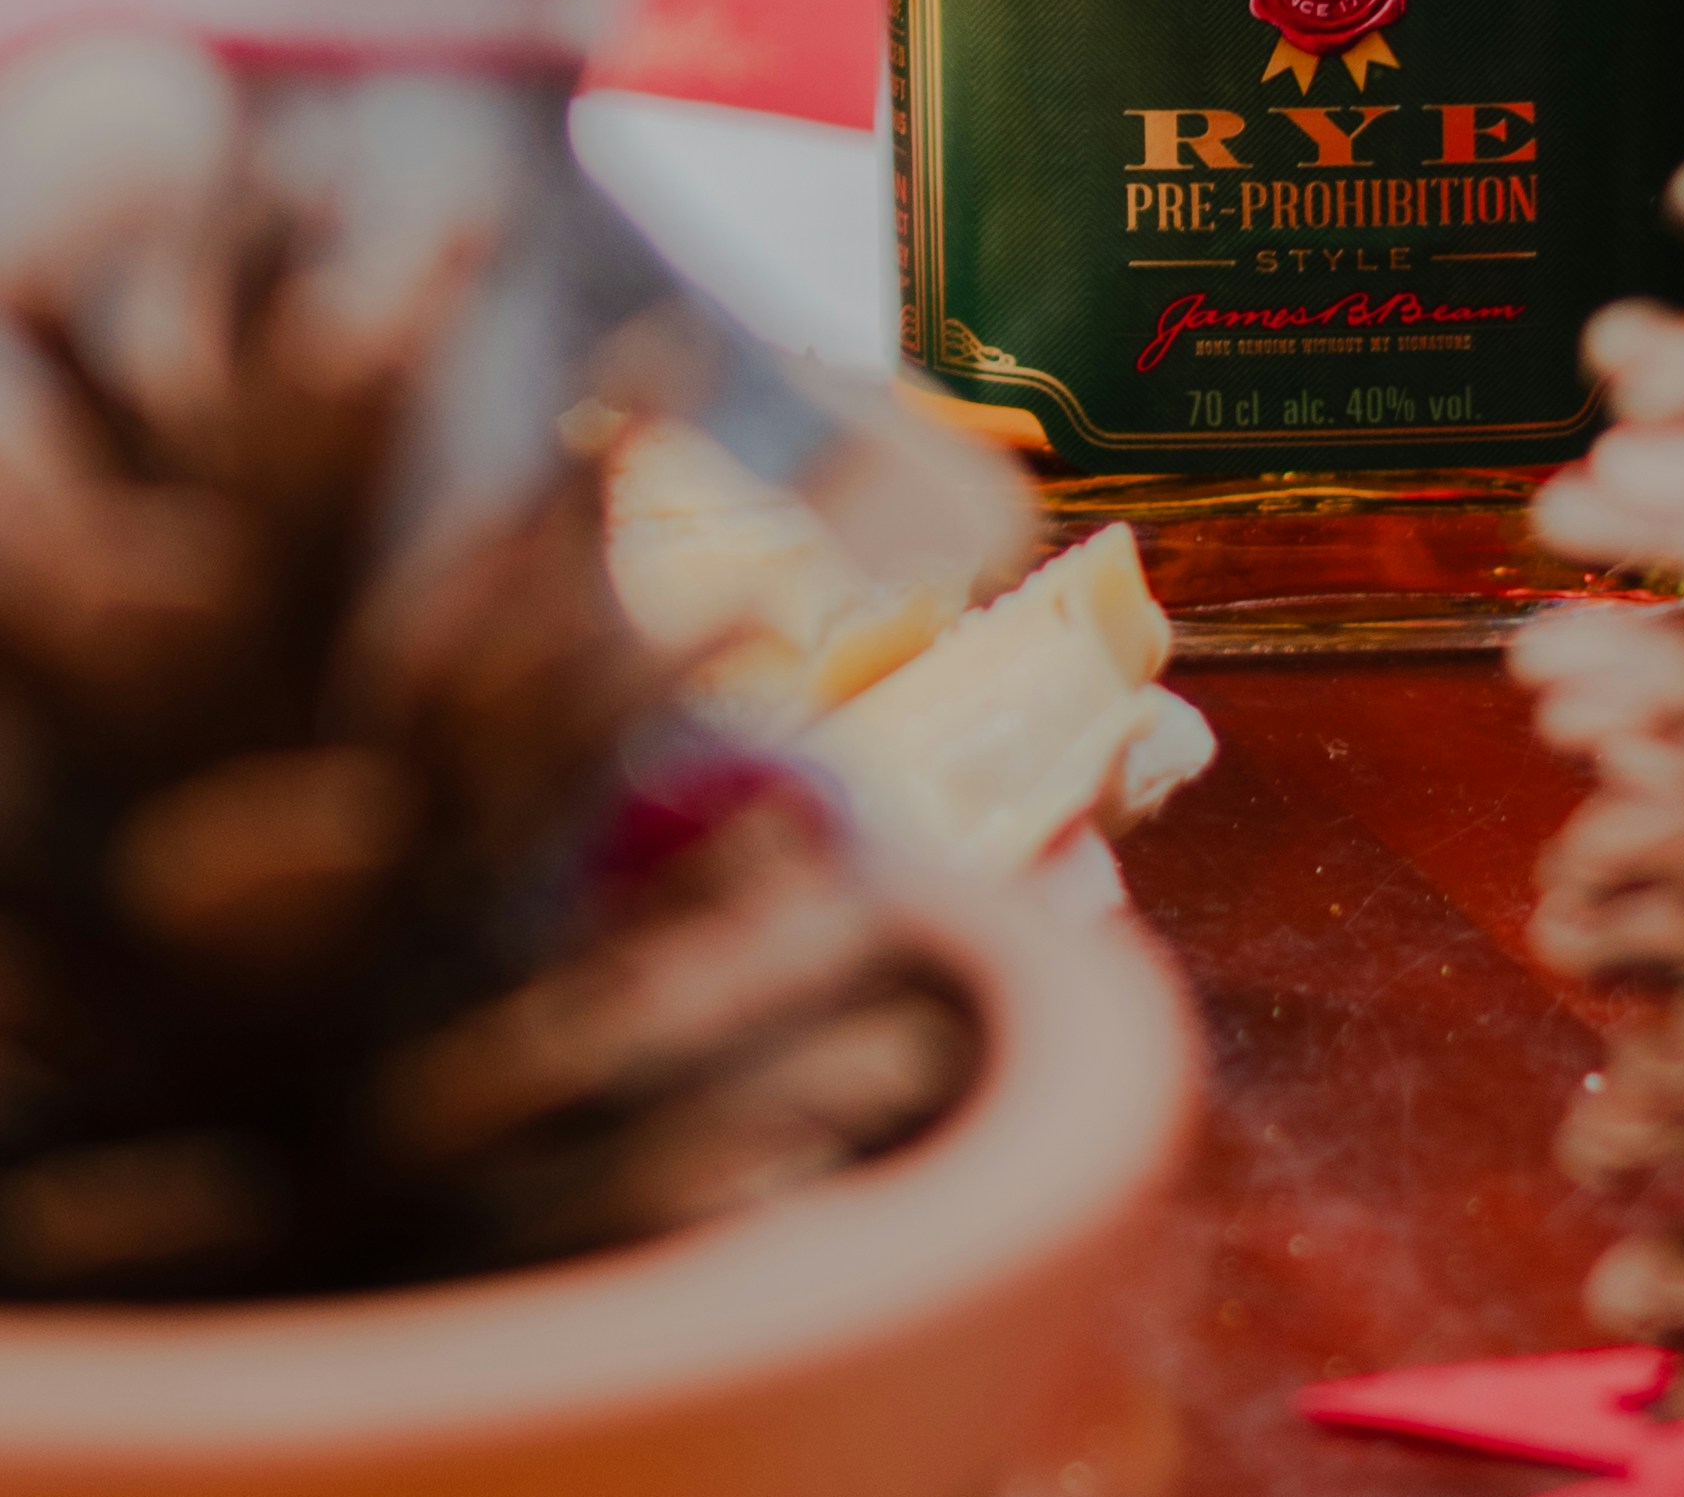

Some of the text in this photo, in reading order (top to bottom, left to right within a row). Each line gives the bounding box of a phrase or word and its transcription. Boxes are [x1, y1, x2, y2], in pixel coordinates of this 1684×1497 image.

[1123, 101, 1537, 171] RYE
[1125, 174, 1537, 232] PRE-PROHIBITION
[1255, 246, 1412, 272] STYLE
[1136, 292, 1316, 372] James
[1194, 334, 1471, 356] NONE GENUINE WITHOUT MY SIGNATURE
[1186, 385, 1482, 427] 70 cl alc. 40% vol.
